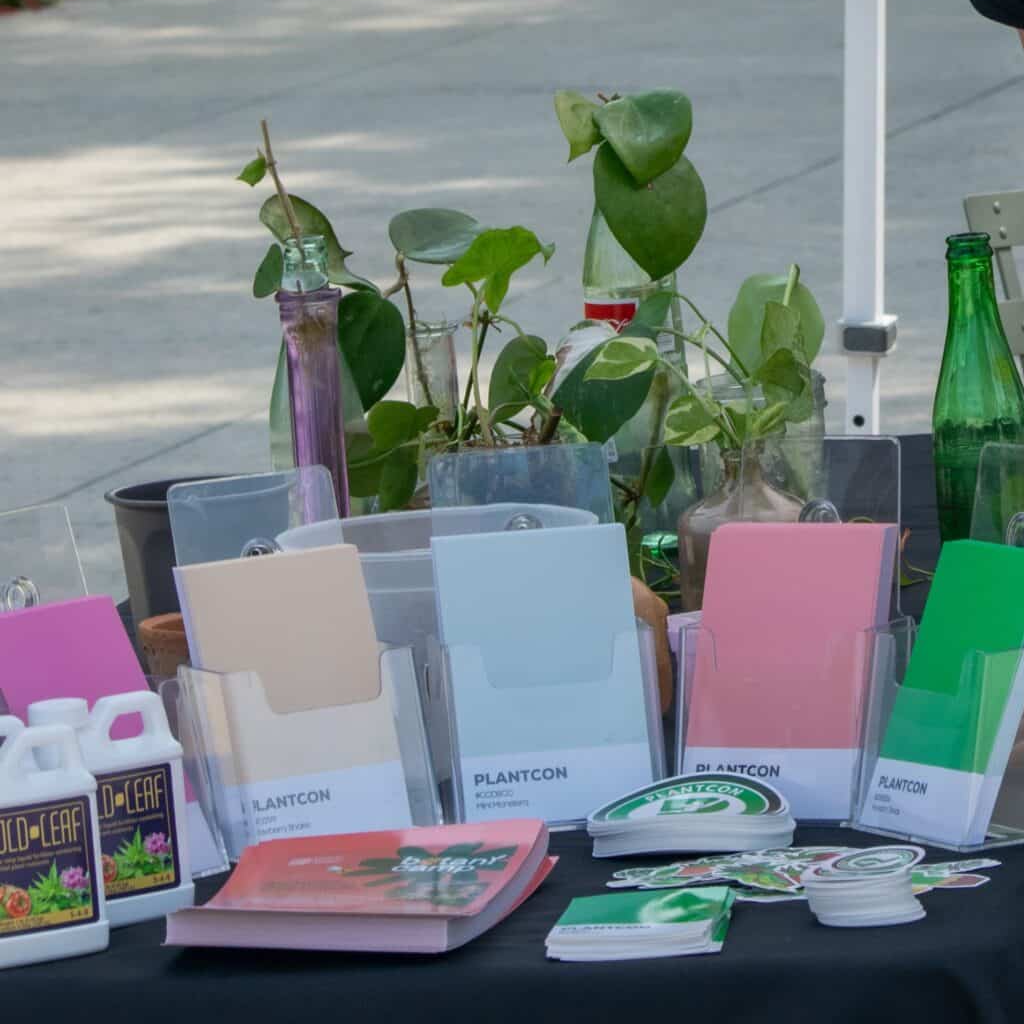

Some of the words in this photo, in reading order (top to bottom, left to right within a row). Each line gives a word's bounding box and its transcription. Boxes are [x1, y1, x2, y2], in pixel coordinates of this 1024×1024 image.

[473, 765, 568, 787] PLANTCON
[695, 763, 780, 777] PLANTCON
[125, 774, 163, 814] LEAF
[644, 783, 745, 802] PLANTCON
[878, 775, 928, 796] PLANTCON
[40, 805, 82, 848] LEAF
